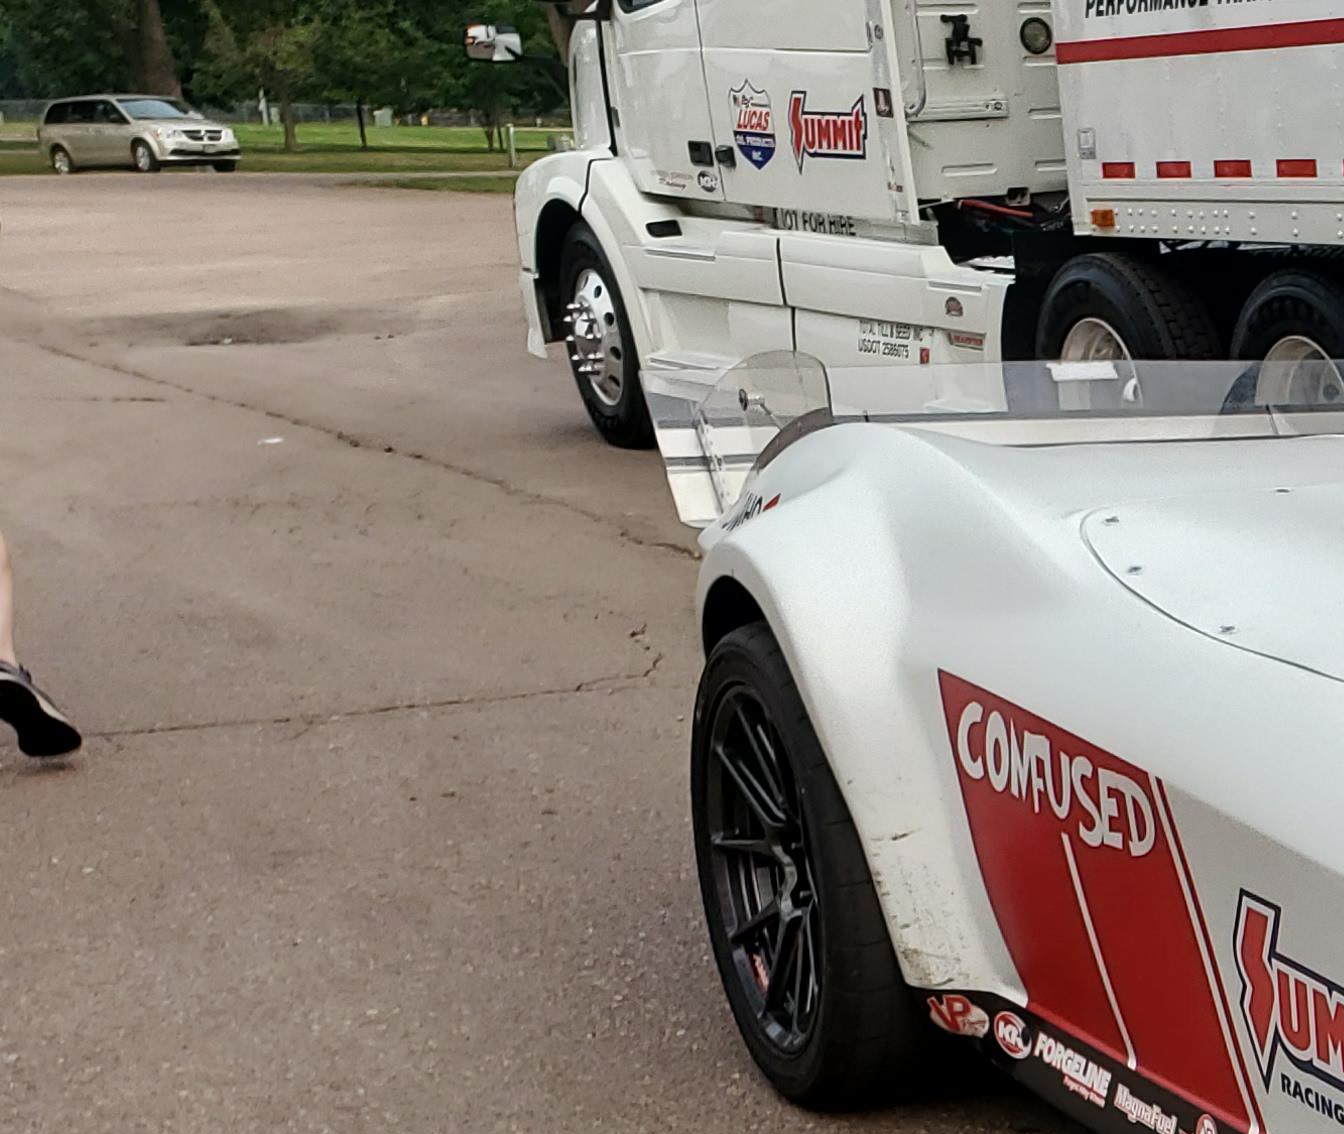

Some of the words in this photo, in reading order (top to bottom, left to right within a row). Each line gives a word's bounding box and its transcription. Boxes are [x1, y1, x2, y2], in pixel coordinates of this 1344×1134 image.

[1085, 0, 1209, 18] PERFORM
[737, 109, 770, 131] LUCAS
[802, 211, 826, 234] FOR
[957, 701, 1156, 857] CONFUSED
[927, 994, 972, 1033] VP
[1034, 1031, 1112, 1097] FORGELINE
